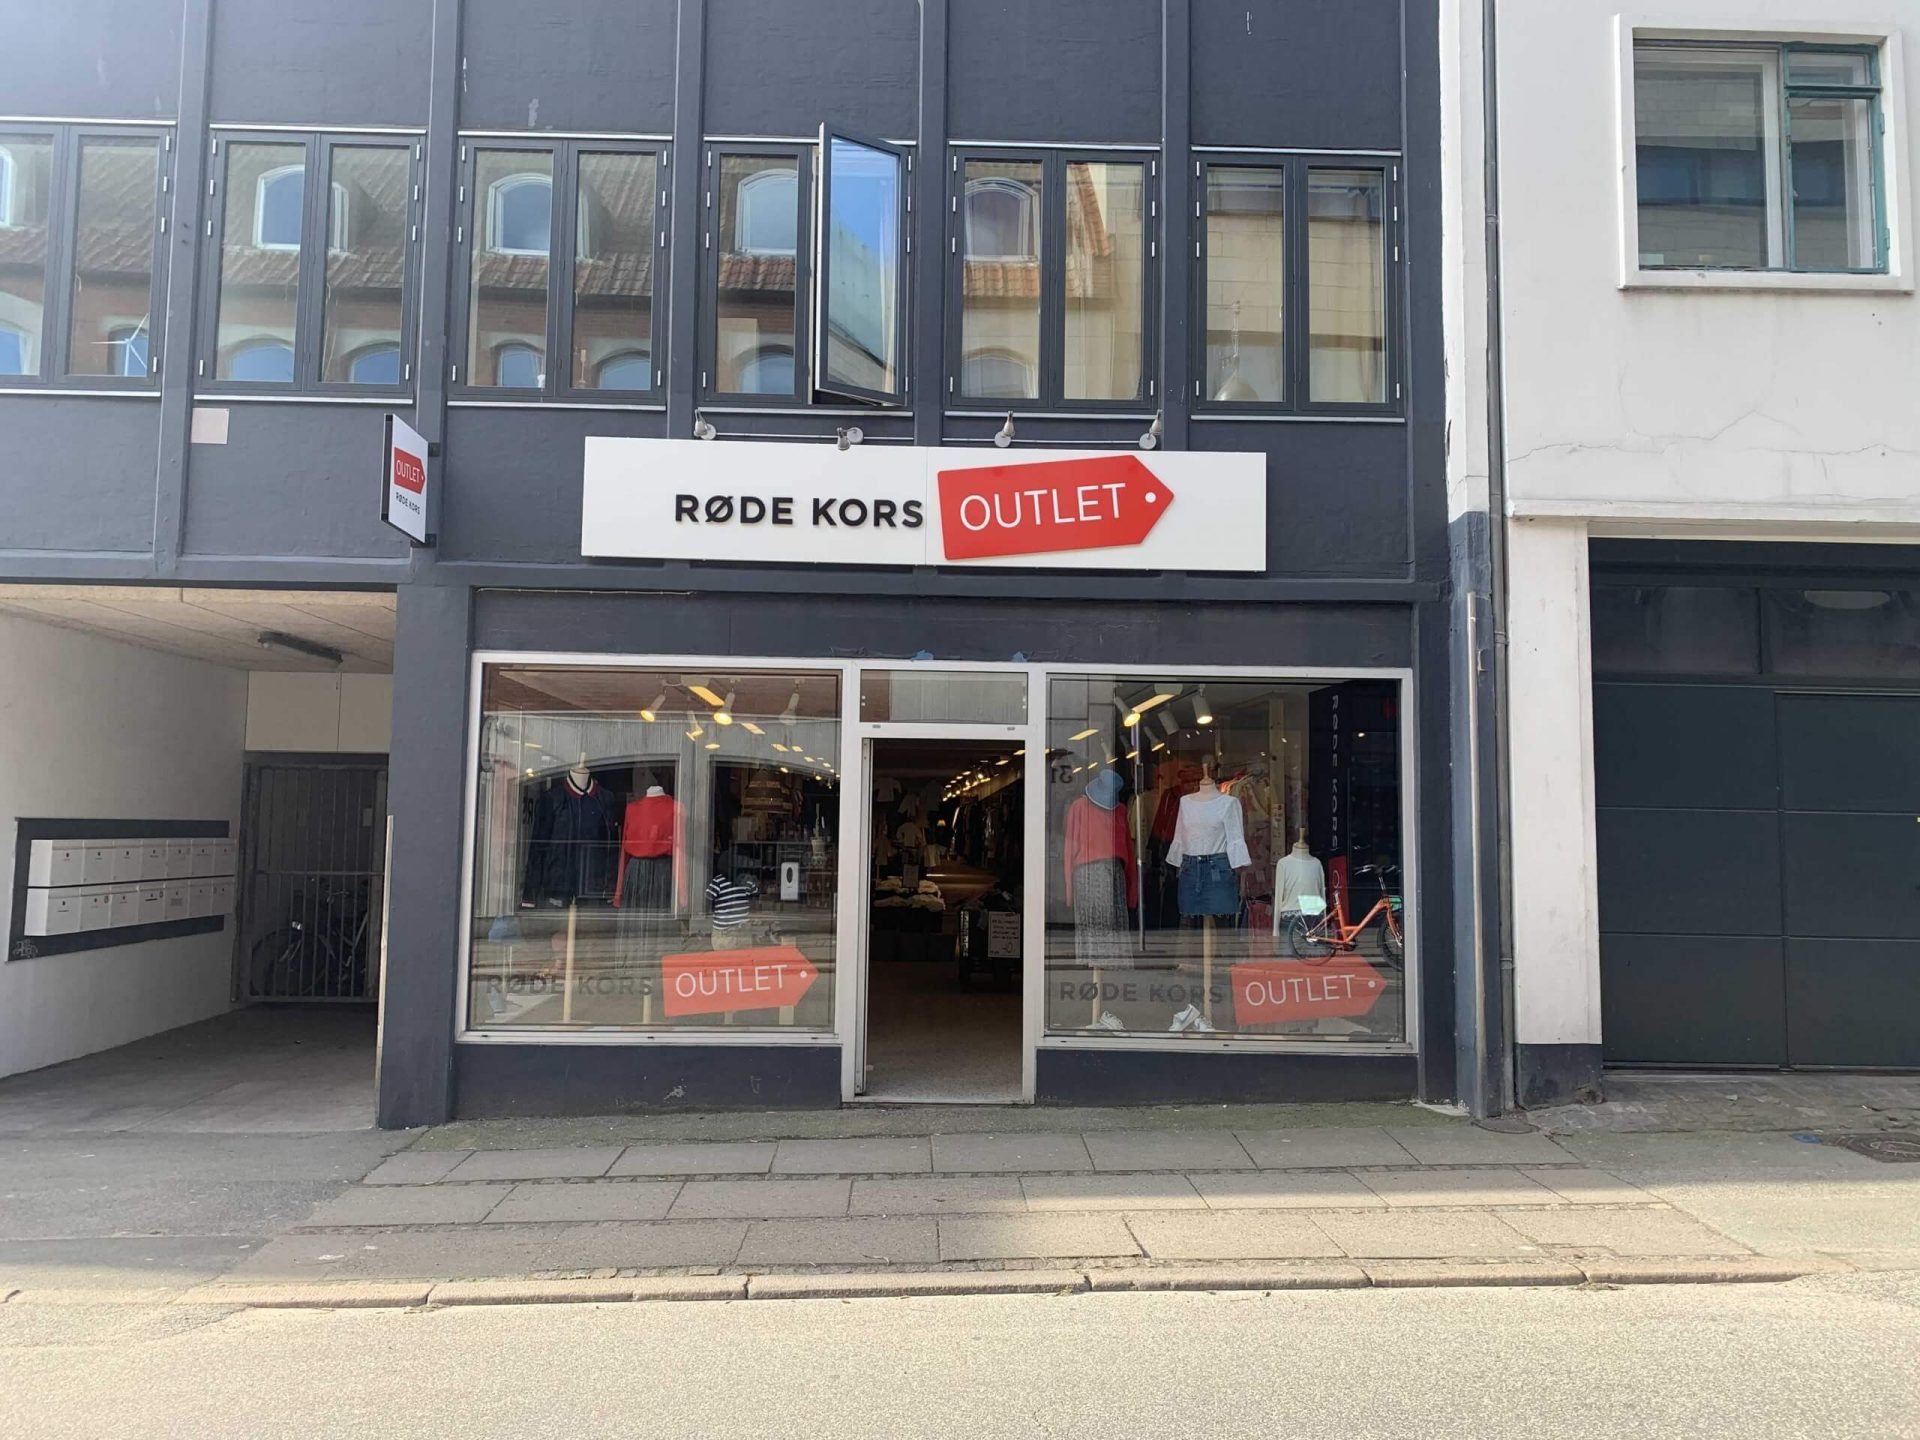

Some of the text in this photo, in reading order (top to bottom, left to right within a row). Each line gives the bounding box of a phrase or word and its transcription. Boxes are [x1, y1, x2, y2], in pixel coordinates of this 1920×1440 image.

[396, 460, 420, 483] OUTLET
[395, 491, 421, 515] RØDE KORS
[675, 493, 924, 530] RØDE KORS
[959, 482, 1127, 532] OUTLET
[487, 975, 653, 996] RØDE KORS
[675, 963, 788, 999] OUTLET
[1060, 981, 1224, 1004] RØDE KORS
[1245, 974, 1355, 1007] OUTLET
